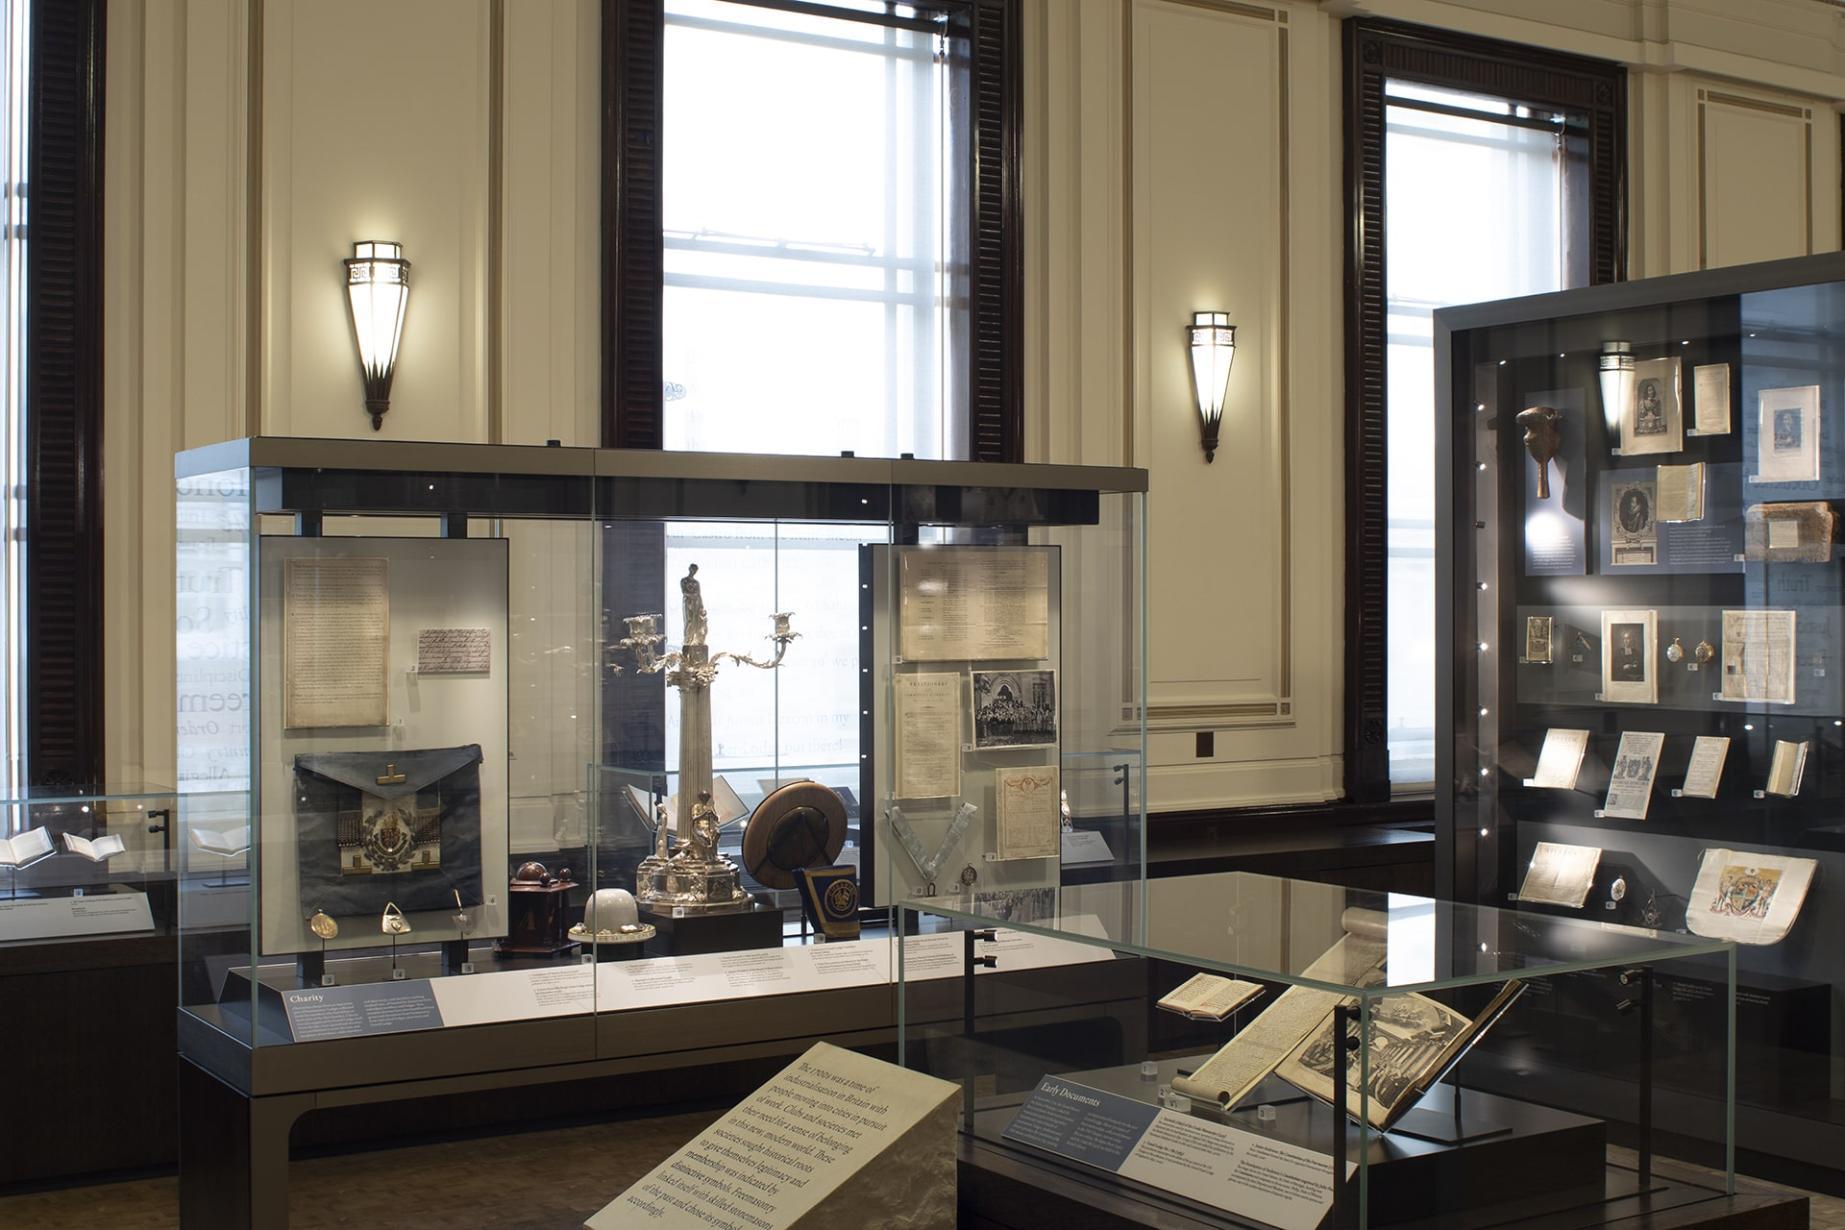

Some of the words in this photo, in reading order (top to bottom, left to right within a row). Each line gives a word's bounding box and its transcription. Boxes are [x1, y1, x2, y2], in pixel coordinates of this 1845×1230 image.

[289, 994, 324, 1003] Charity
[783, 1072, 839, 1097] industrialisation
[844, 1094, 871, 1108] Britain
[869, 1104, 889, 1114] with
[845, 1080, 867, 1091] time
[1041, 1082, 1061, 1096] Early
[1059, 1087, 1102, 1108] Documents
[742, 1105, 761, 1117] their
[757, 1113, 780, 1123] need
[766, 1085, 795, 1098] people
[791, 1093, 820, 1109] moving
[831, 1107, 853, 1118] cities
[855, 1116, 887, 1131] pursuit
[783, 1104, 805, 1118] Clubs
[802, 1110, 822, 1122] and
[815, 1118, 848, 1133] societies
[845, 1129, 863, 1139] met
[788, 1125, 810, 1136] sense
[806, 1131, 826, 1140] of
[815, 1132, 854, 1155] belonging
[713, 1128, 743, 1144] societies
[737, 1140, 767, 1153] sought
[762, 1145, 800, 1165] historical
[793, 1160, 815, 1173] roots
[763, 1132, 792, 1146] modern
[813, 1149, 836, 1163] These
[684, 1150, 726, 1173] membership
[736, 1171, 774, 1190] indicated
[703, 1143, 724, 1153] give
[720, 1146, 758, 1167] themselves
[754, 1160, 792, 1183] legitimacy
[789, 1177, 810, 1188] and
[656, 1170, 682, 1186] linked
[675, 1180, 699, 1193] itself
[692, 1186, 713, 1200] with
[706, 1195, 735, 1210] skilled
[670, 1160, 706, 1180] distinctive
[730, 1186, 776, 1214] Freemasonry
[655, 1192, 678, 1203] past
[672, 1199, 692, 1209] and
[684, 1202, 706, 1218] chose
